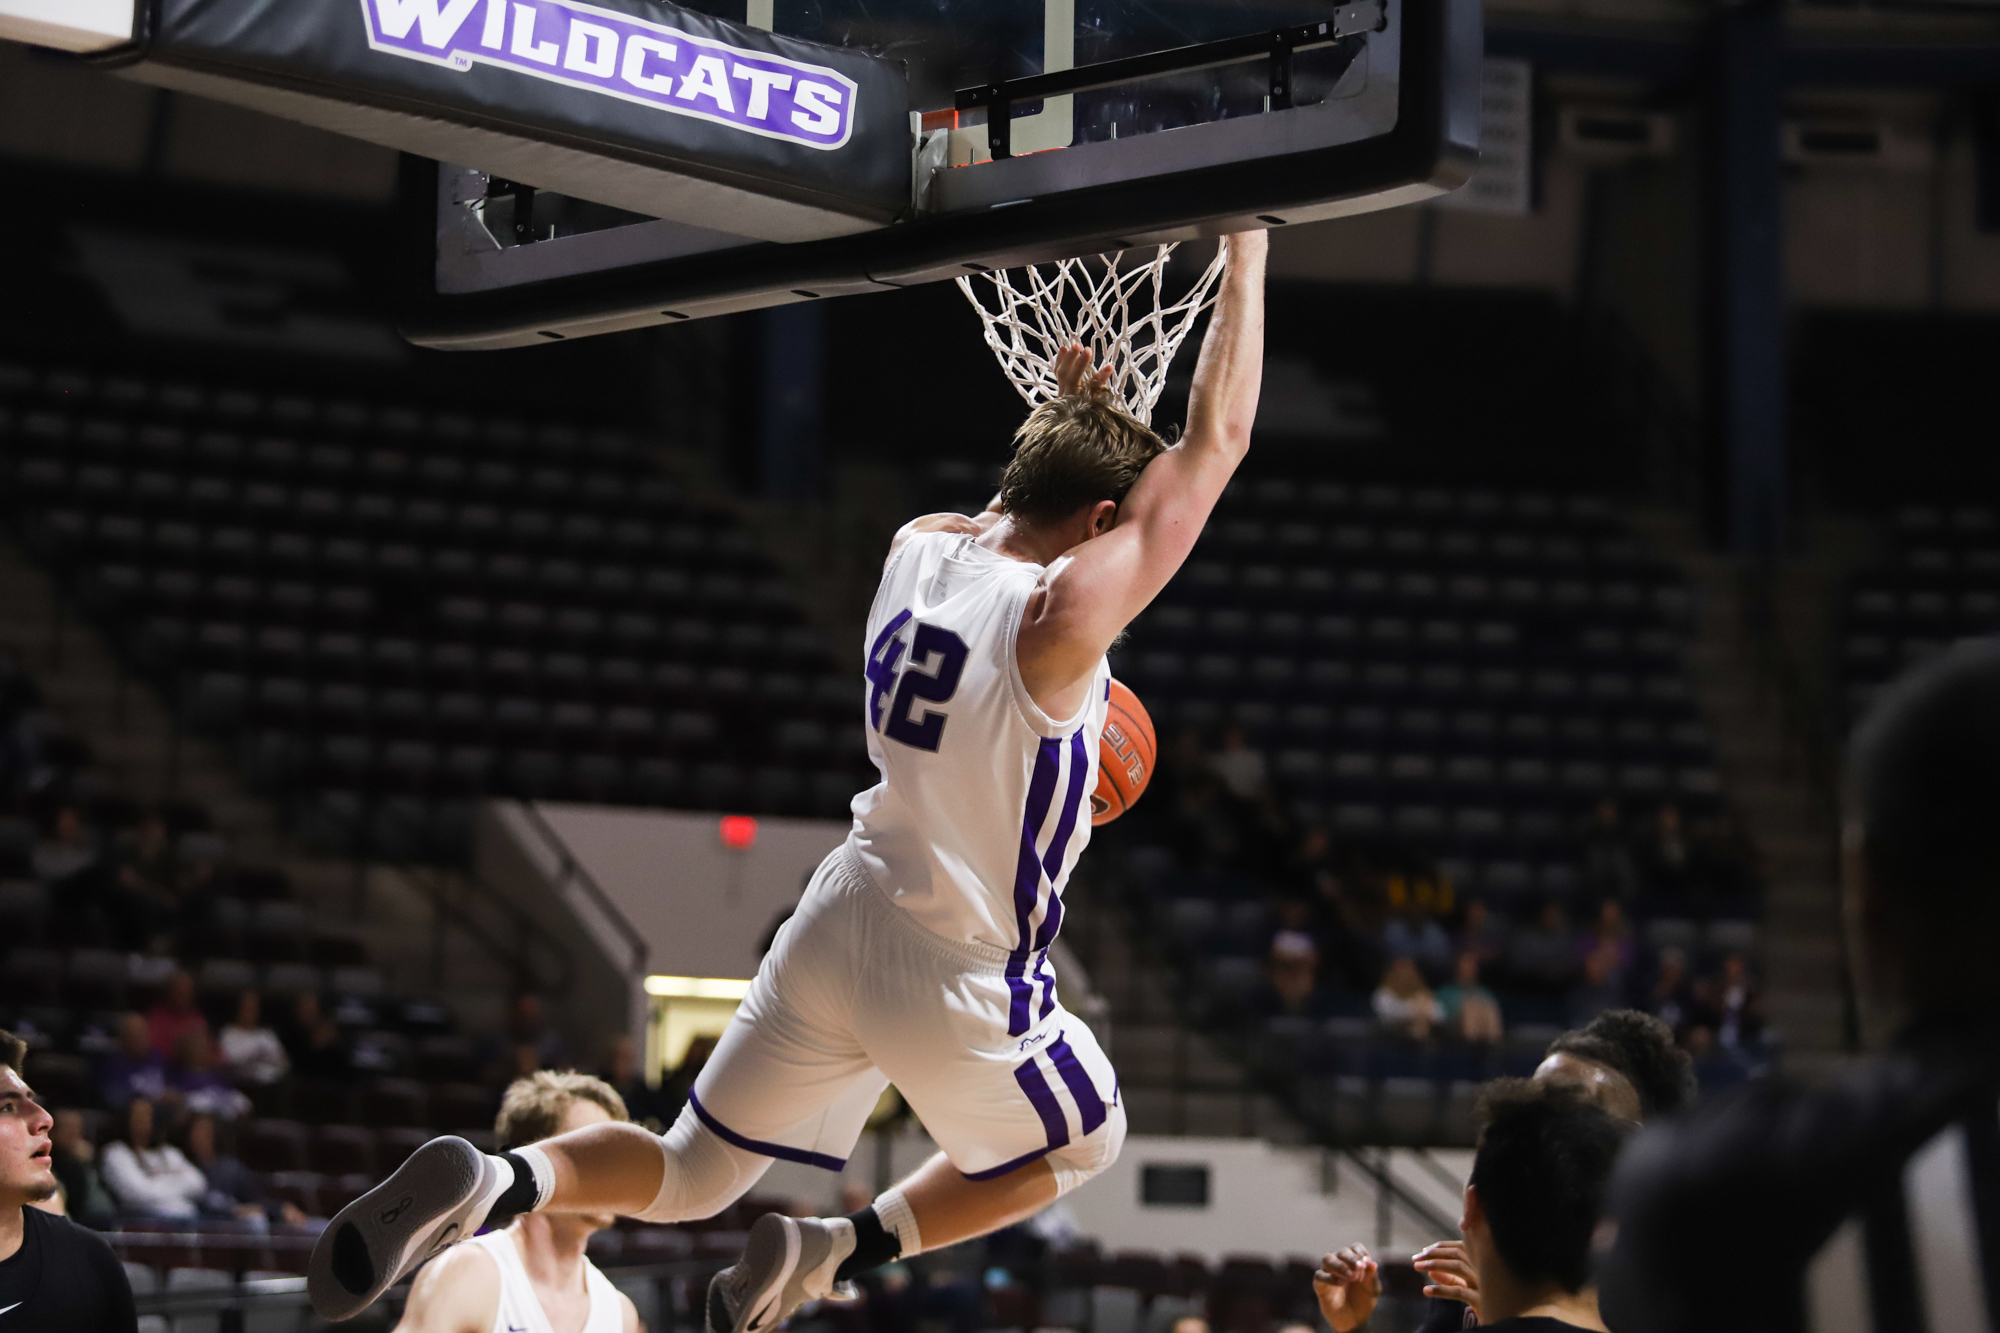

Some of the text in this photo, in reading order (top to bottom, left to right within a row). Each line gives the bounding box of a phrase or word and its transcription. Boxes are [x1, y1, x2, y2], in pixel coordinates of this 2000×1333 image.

[374, 0, 842, 136] WILDCATS
[865, 606, 970, 754] 42
[1101, 723, 1146, 788] ELITE
